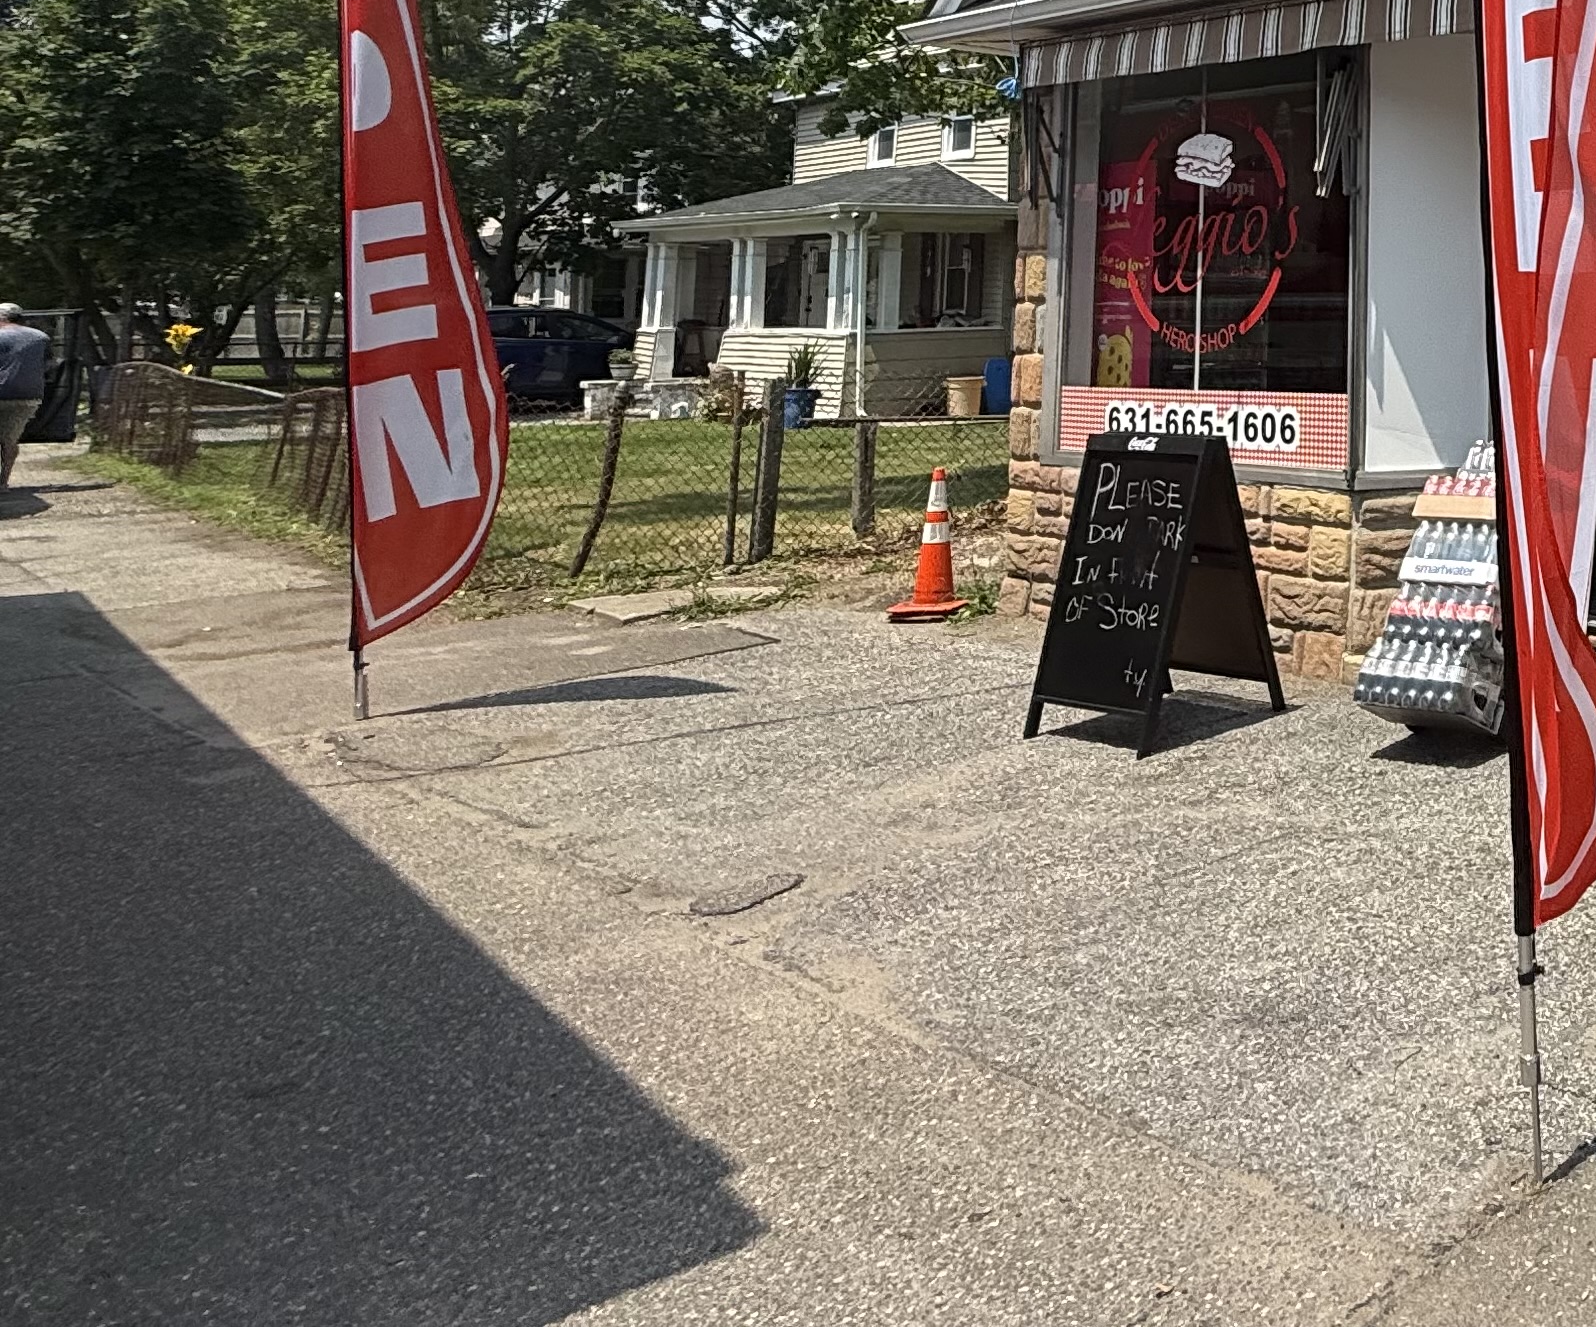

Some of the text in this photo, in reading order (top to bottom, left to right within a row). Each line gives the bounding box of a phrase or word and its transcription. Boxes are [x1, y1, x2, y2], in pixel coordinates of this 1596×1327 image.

[1199, 323, 1237, 354] SHOP
[1108, 406, 1296, 445] 631-665-1606
[1089, 462, 1184, 522] PLEASE
[1072, 555, 1101, 586] IN
[1414, 564, 1475, 577] smartwater
[1065, 593, 1093, 622] OF
